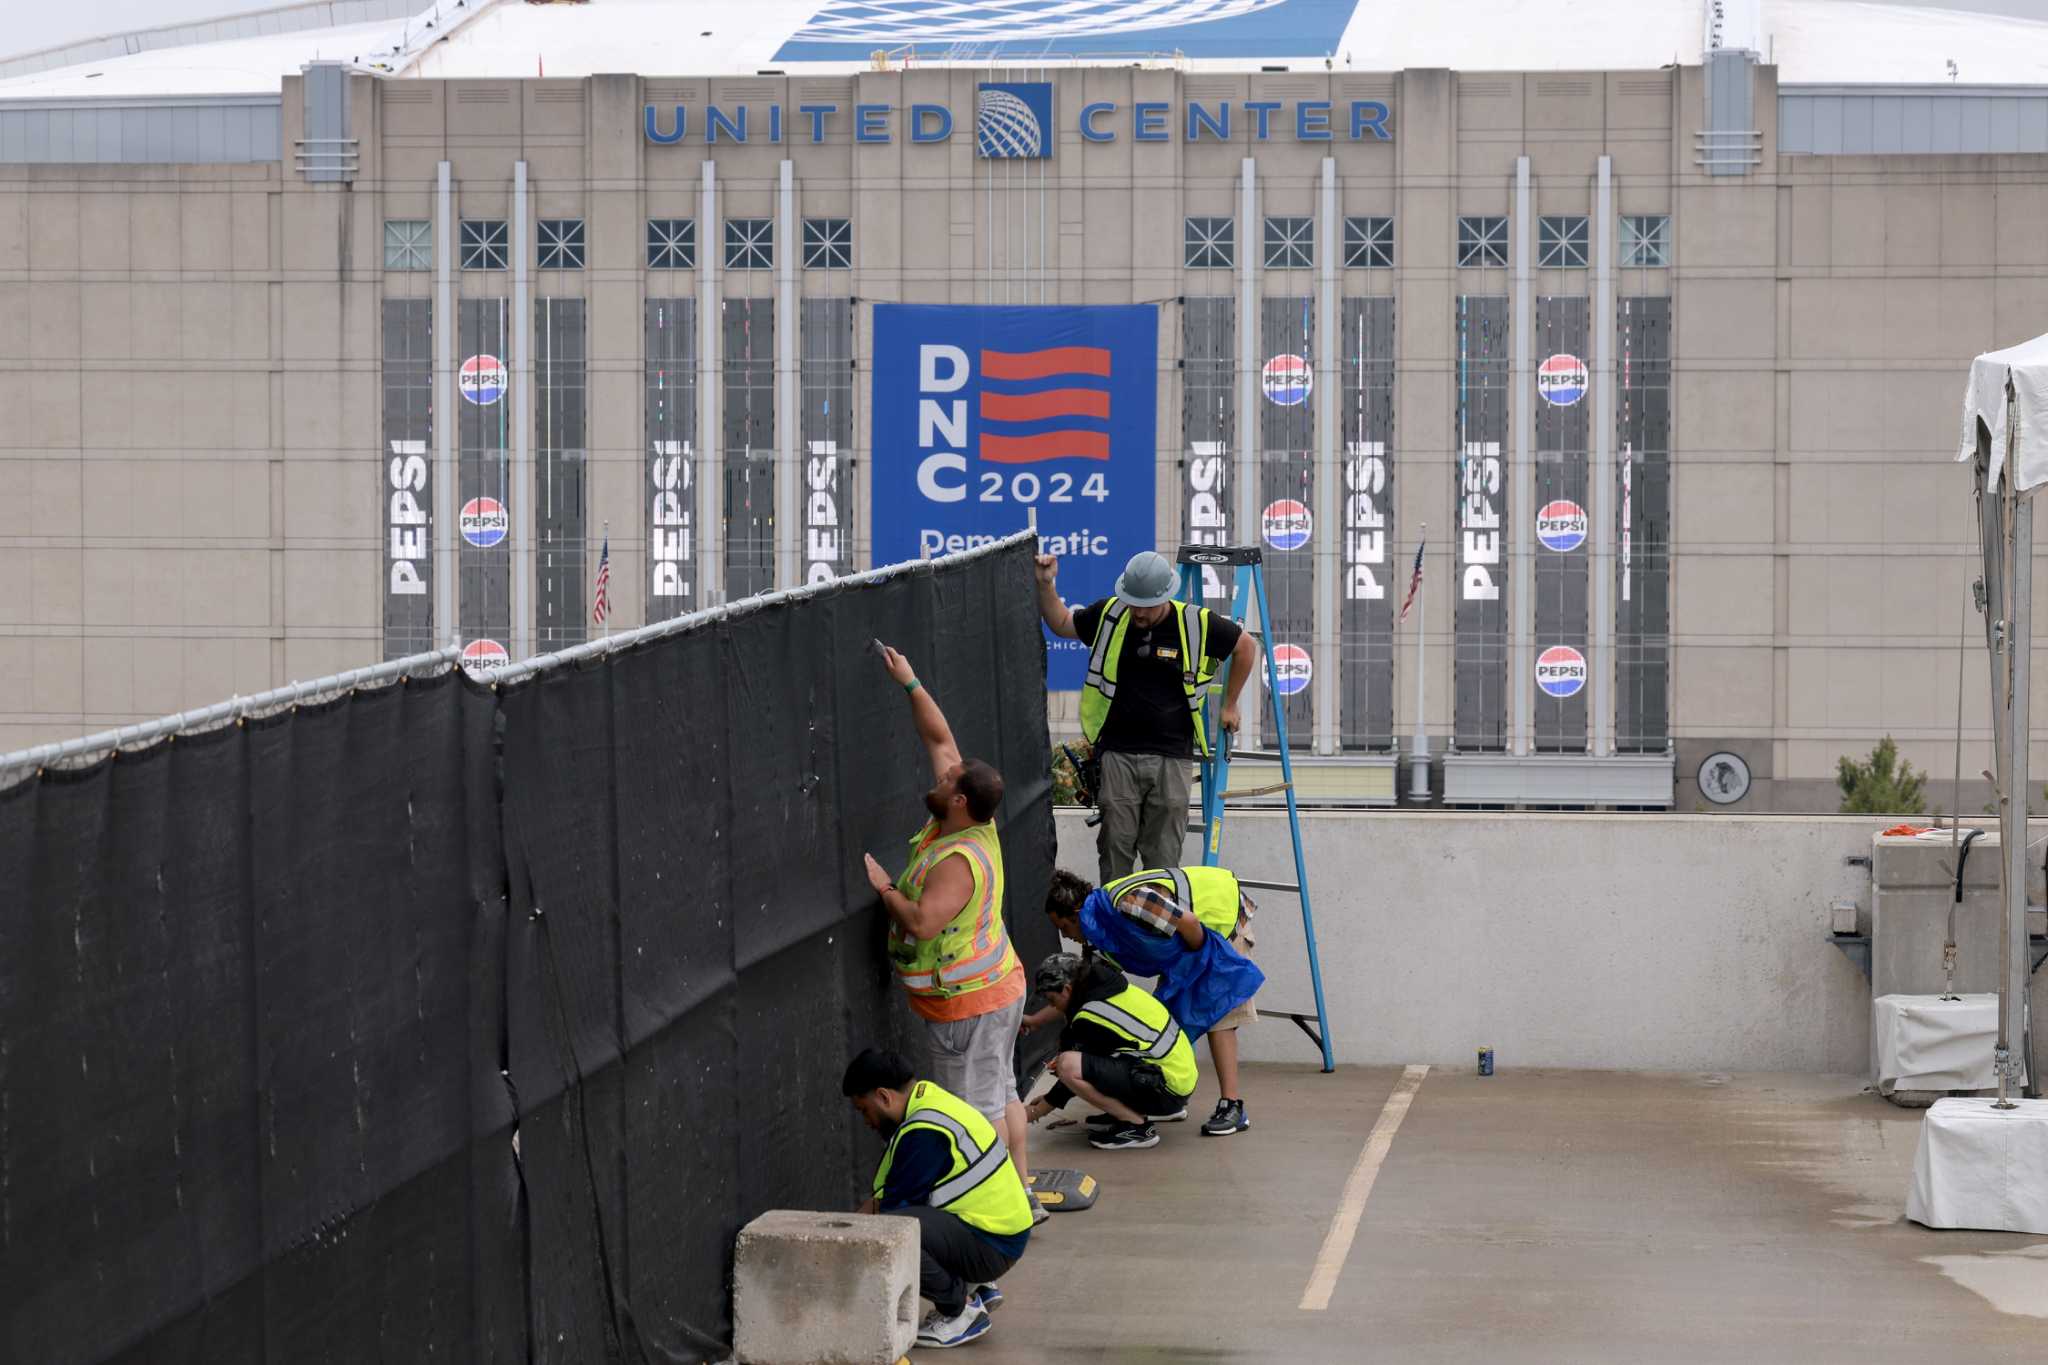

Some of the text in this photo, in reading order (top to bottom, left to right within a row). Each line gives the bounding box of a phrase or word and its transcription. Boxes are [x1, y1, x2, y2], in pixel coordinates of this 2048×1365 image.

[644, 100, 1392, 144] UNITED CENTER
[461, 374, 504, 385] PEPSI
[1265, 374, 1309, 385] PEPSI
[1540, 374, 1585, 385] PEPSI
[917, 344, 970, 503] DNC
[979, 472, 1110, 502] 2024
[391, 440, 427, 594] PEPSI
[462, 517, 505, 527] PEPSI
[653, 440, 690, 596] PEPSI
[1264, 519, 1309, 530] PEPSI
[1346, 441, 1385, 599] PEPSI
[1463, 441, 1500, 600] PEPSI
[1539, 520, 1585, 531] PEPSI
[920, 528, 1109, 556] Demratic
[1538, 666, 1584, 677] PEPSI
